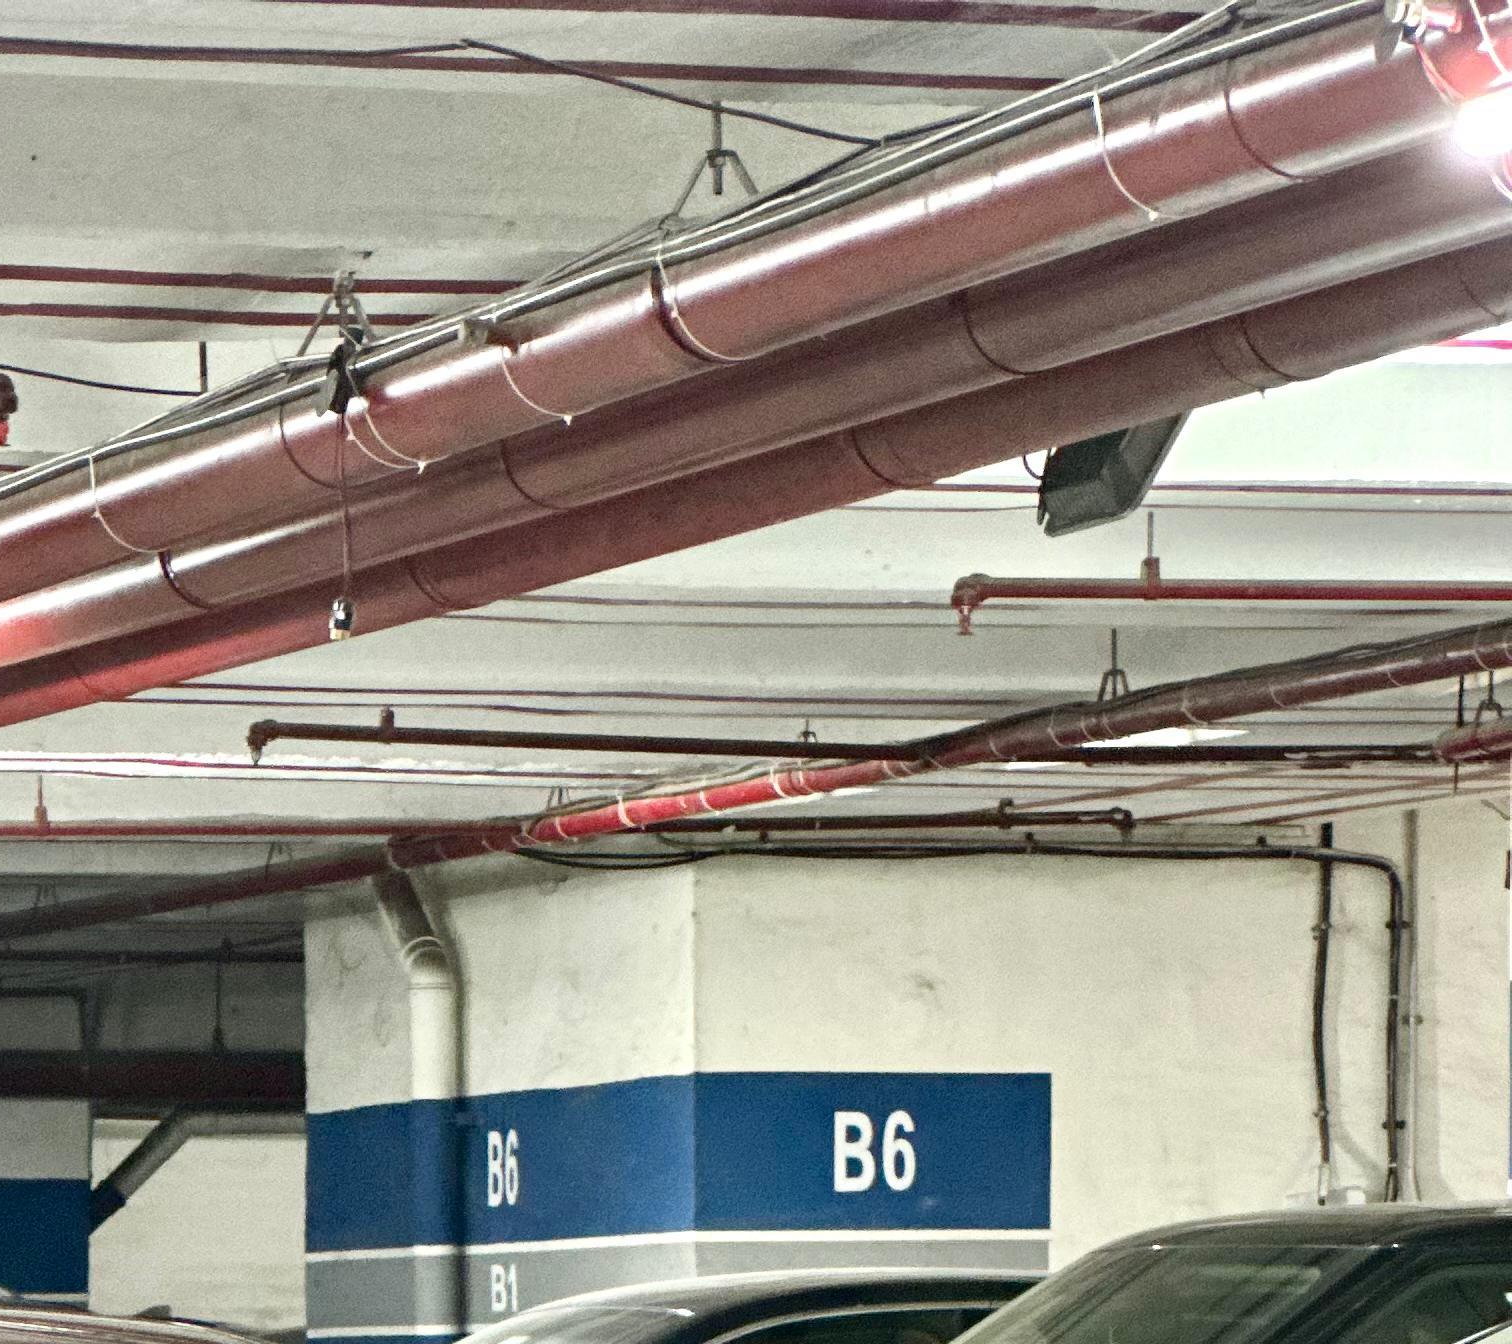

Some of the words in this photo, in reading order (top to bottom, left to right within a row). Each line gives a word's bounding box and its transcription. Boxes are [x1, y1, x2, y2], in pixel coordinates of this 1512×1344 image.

[487, 1128, 520, 1207] B6
[833, 1110, 916, 1192] B6
[490, 1264, 518, 1313] B1
